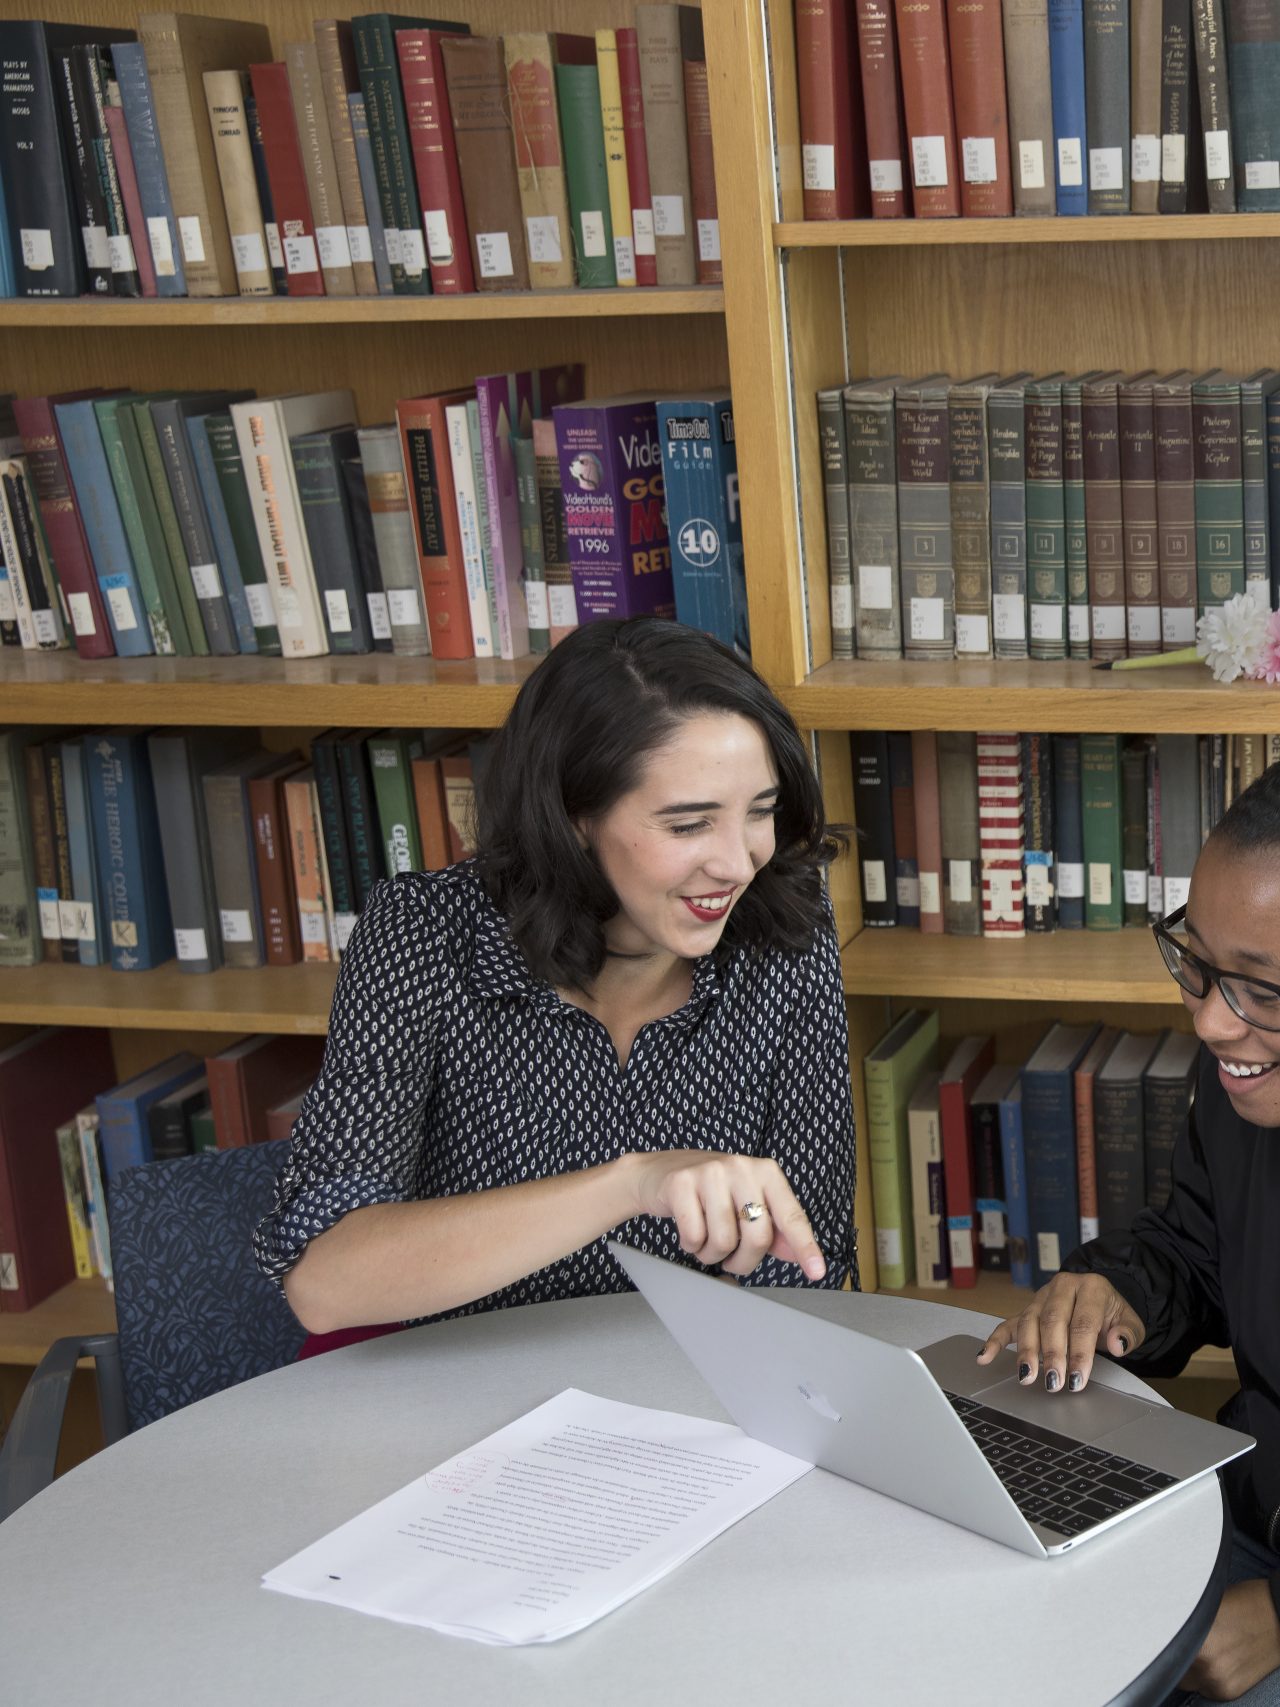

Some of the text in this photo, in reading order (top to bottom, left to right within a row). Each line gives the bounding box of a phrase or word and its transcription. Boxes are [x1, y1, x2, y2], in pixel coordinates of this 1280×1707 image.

[3, 84, 34, 92] DRAMATISTS
[851, 414, 887, 425] The Great
[902, 412, 940, 423] The Great
[1202, 416, 1232, 430] Ptolemy
[566, 428, 597, 437] UNLEASH
[667, 418, 711, 440] Time Out
[912, 422, 931, 434] Ideas
[1086, 430, 1118, 442] Aristotle
[1123, 430, 1154, 442] Aristotle
[1158, 436, 1191, 449] Augustine
[1198, 434, 1238, 448] Copernicus
[668, 441, 713, 460] Film
[673, 460, 713, 471] Guide
[1205, 452, 1231, 467] Kepler
[474, 451, 488, 518] THERAPEUTIC
[413, 435, 439, 551] PHILIP FRENEAU
[563, 492, 613, 506] VideoHound's
[565, 505, 614, 513] GOLDEN
[541, 489, 559, 562] MASTERS
[567, 512, 615, 526] MOVIE
[567, 527, 615, 536] RETRIEVER
[578, 538, 610, 554] 1996
[683, 528, 716, 554] 10
[1137, 539, 1143, 549] 9
[1215, 540, 1226, 550] 16
[1250, 539, 1261, 549] 15
[101, 759, 117, 797] THE
[105, 802, 124, 867] HEROIC
[352, 812, 368, 854] BLACK
